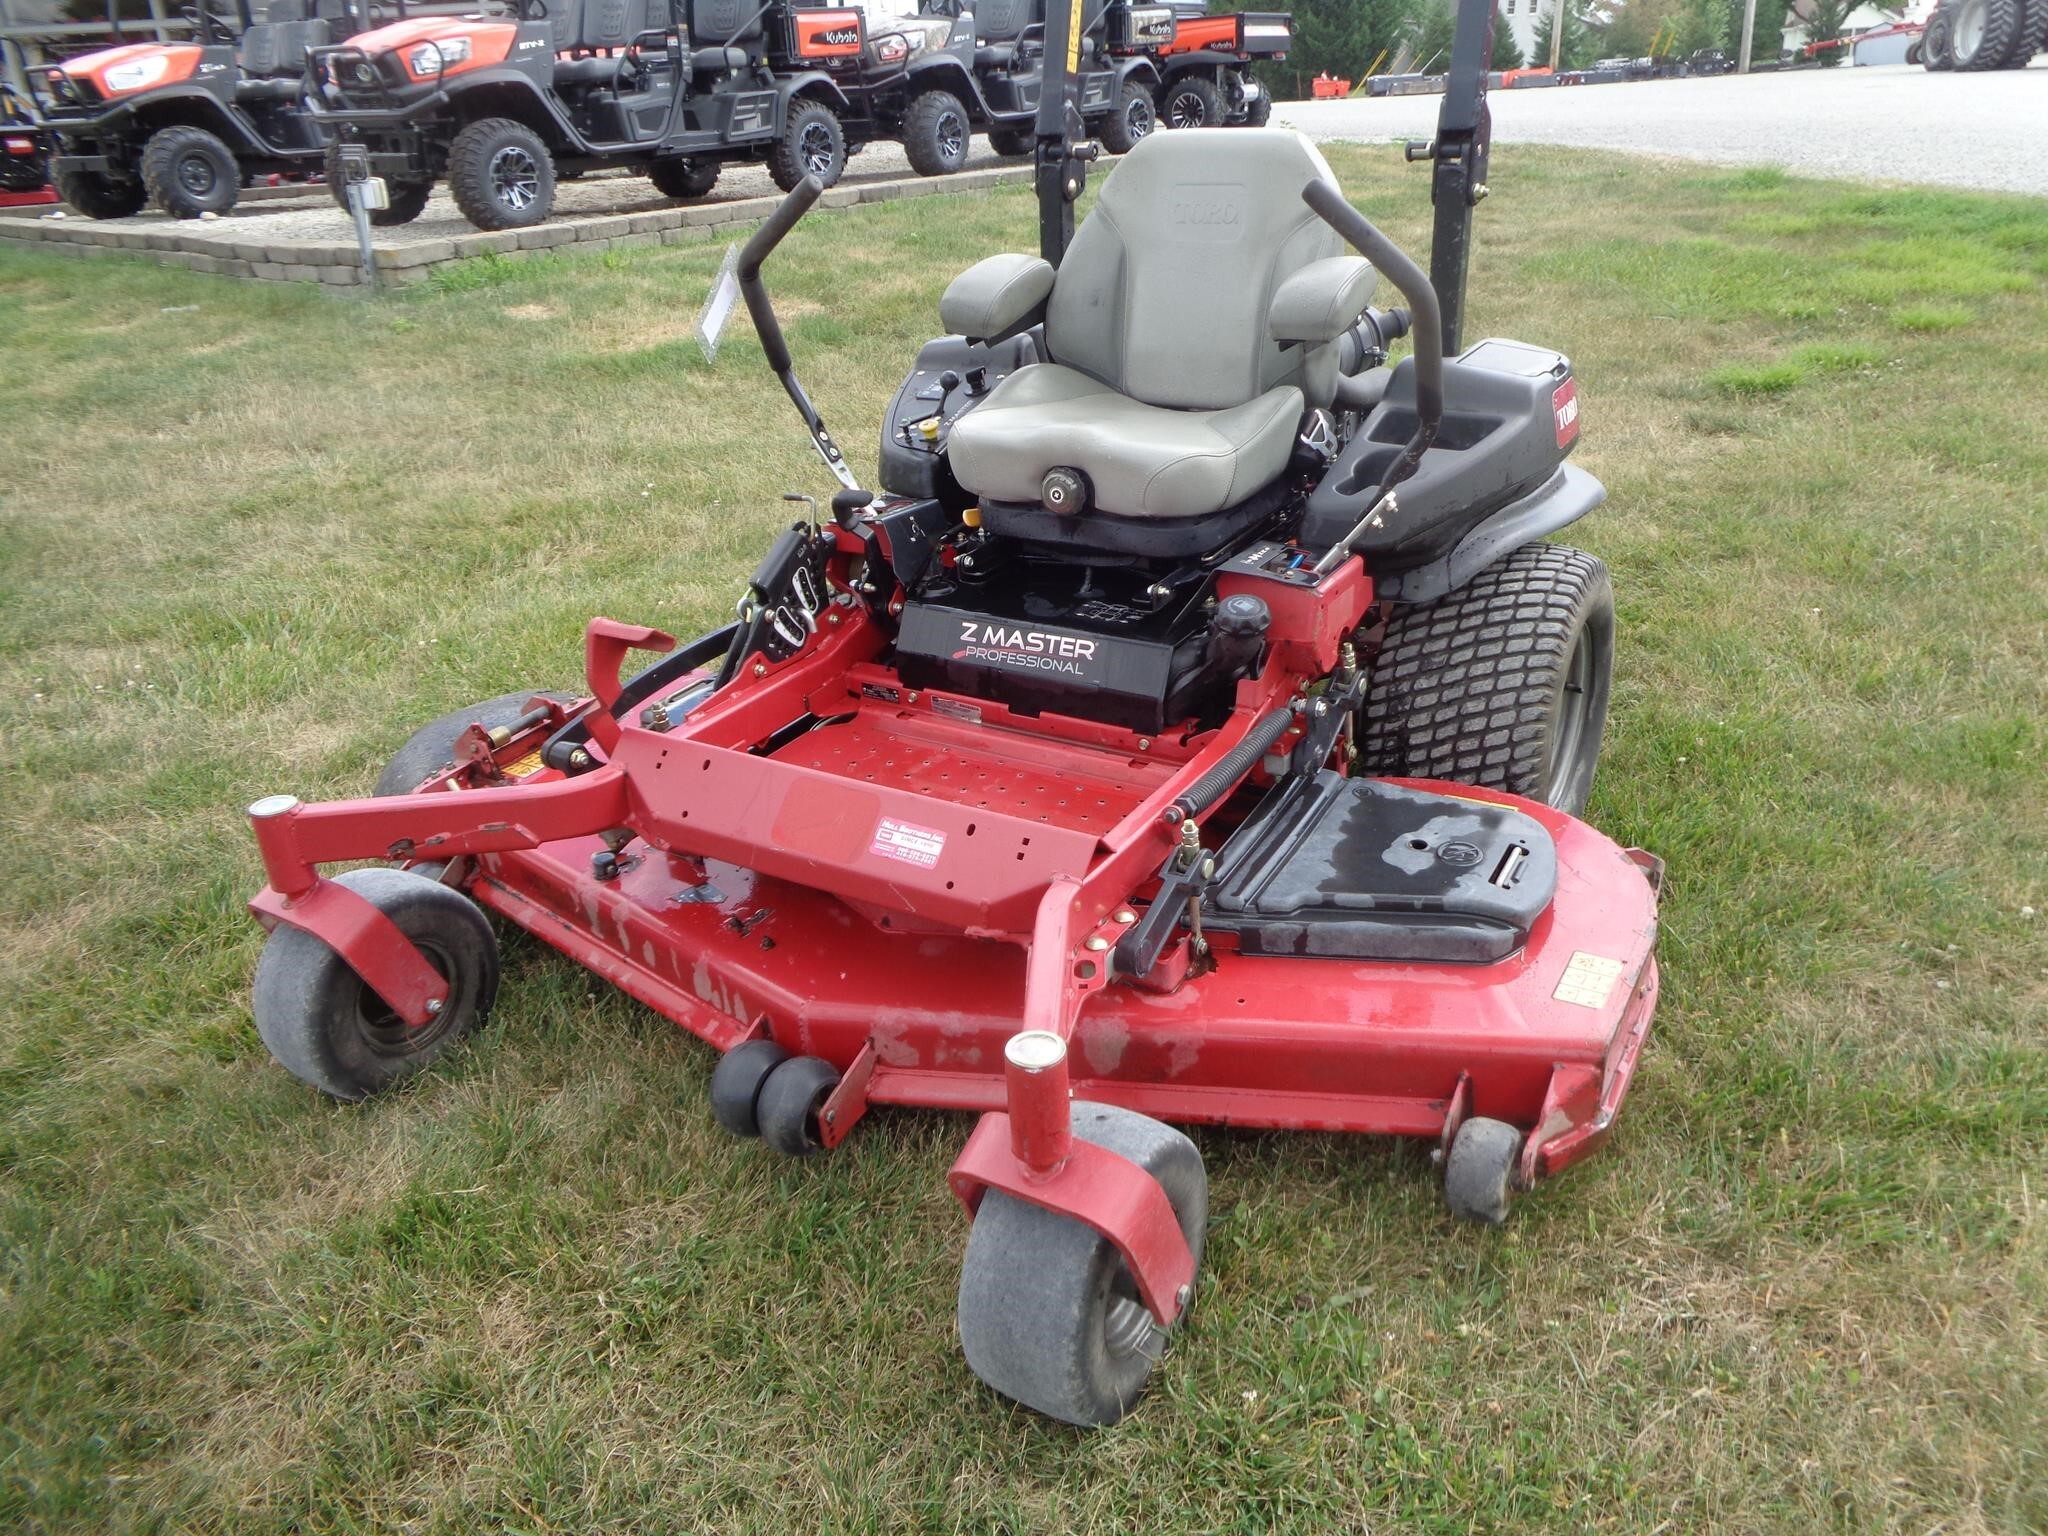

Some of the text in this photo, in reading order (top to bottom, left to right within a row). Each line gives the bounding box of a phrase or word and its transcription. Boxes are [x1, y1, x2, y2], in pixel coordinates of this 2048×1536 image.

[826, 30, 858, 44] Kubota
[1175, 202, 1240, 225] TORO
[960, 621, 1096, 661] Z MASTER
[965, 645, 1085, 676] PROFESSIONAL
